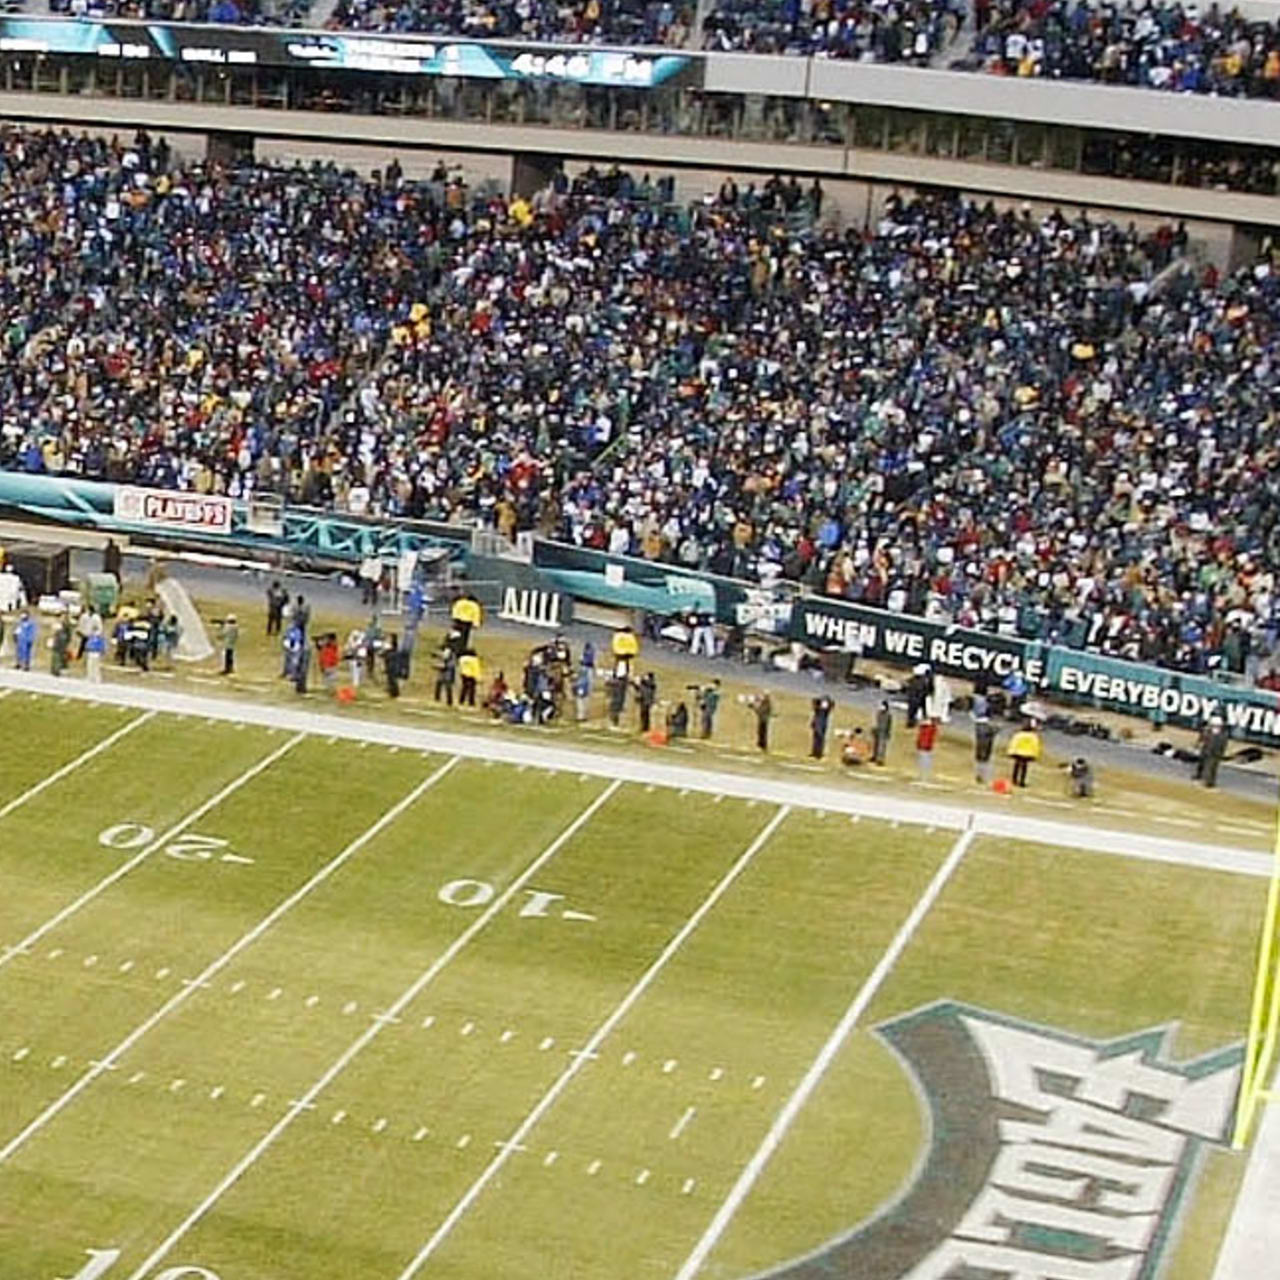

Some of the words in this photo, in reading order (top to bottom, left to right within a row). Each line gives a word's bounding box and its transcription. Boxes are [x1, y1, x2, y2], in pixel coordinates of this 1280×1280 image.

[804, 611, 877, 649] WHEN
[885, 628, 924, 658] WE
[930, 638, 1049, 688] RECYCLE,
[1059, 665, 1218, 721] EVERYBODY
[99, 822, 230, 862] 20
[438, 878, 572, 918] 10
